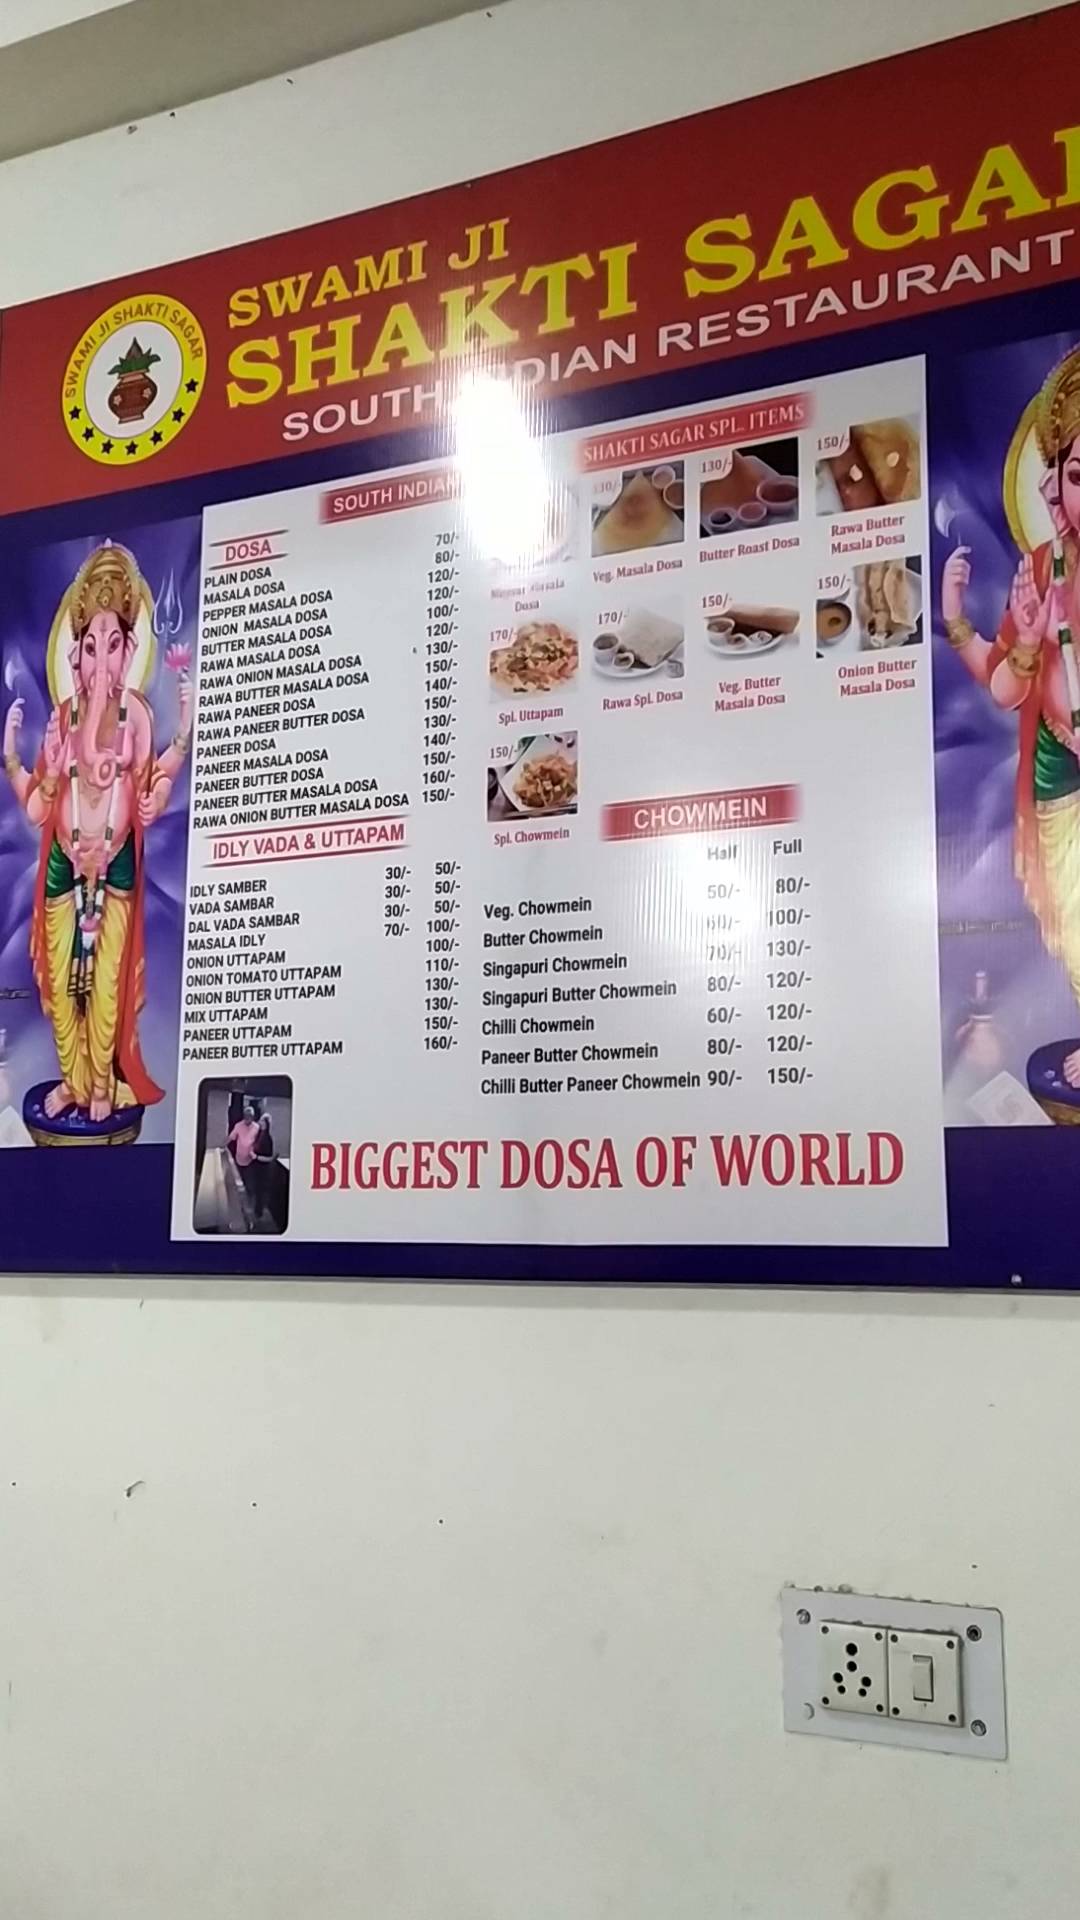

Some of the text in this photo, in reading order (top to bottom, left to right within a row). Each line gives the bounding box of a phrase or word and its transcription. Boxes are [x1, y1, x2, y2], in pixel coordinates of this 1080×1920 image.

[228, 218, 510, 329] SWAMI JI
[227, 242, 638, 408] SHAKTI
[283, 380, 444, 441] SOUTH
[657, 228, 1075, 356] RESTAURANT
[65, 302, 203, 399] SWAMI JI SHAKTI SAGAR
[584, 402, 805, 463] SHAKTI SAGAR SPL. ITEMS
[818, 431, 853, 450] 150/-
[333, 486, 393, 514] SOUTH
[831, 516, 904, 537] Rawa Butter
[435, 531, 459, 546] 70/-
[831, 534, 905, 554] Masala Dosa
[225, 539, 272, 561] DOSA
[435, 549, 459, 564] 80/-
[699, 537, 800, 562] Butter Roast Dosa
[204, 566, 272, 588] PLAIN DOSA
[427, 567, 459, 583] 120/-
[616, 562, 654, 578] Masala
[656, 559, 683, 572] Dosa
[818, 571, 854, 589] 150/-
[203, 581, 285, 605] MASALA DOSA
[427, 585, 459, 601] 120/-
[202, 590, 333, 622] PEPPER MASALA DOSA
[427, 604, 459, 619] 100/-
[202, 608, 328, 639] ONION MASALA DOSA
[598, 610, 631, 625] 170/-
[426, 622, 458, 637] 120/-
[201, 625, 332, 656] BUTTER MASALA DOSA
[200, 643, 321, 673] RAWA MASALA DOSA
[425, 658, 458, 673] 150/-
[837, 659, 917, 678] Onion Butter
[199, 672, 369, 707] RAWA BUTTER MASALA DOSA
[744, 677, 781, 690] Butter
[840, 678, 915, 696] Masala Dosa
[602, 698, 631, 710] Rawa
[656, 691, 683, 703] Dosa
[714, 694, 785, 711] Masala Dosa
[424, 713, 456, 728] 130/-
[519, 708, 563, 721] Uttapam
[196, 738, 276, 759] PANEER DOSA
[423, 750, 455, 765] 150/-
[195, 767, 324, 793] PANEER BUTTER DOSA
[422, 788, 455, 802] 150/-
[193, 793, 409, 828] RAWA ONION BUTTER MASALA DOSA
[634, 797, 766, 829] CHOWMEIN
[213, 824, 404, 859] IDLY VADA & UTTAPAM
[773, 839, 802, 855] Full
[385, 866, 411, 879] 30/-
[435, 861, 461, 875] 50/-
[190, 879, 267, 897] IDLY SAMBER
[384, 884, 411, 898] 30/-
[434, 880, 460, 894] 50/-
[775, 877, 810, 894] 80/-
[189, 896, 274, 915] VADA SAMBAR
[384, 903, 410, 917] 30/-
[434, 899, 460, 913] 50/-
[483, 897, 592, 921] Veg. Chowmein
[188, 913, 300, 933] DAL VADA SAMBAR
[426, 918, 460, 932] 100/-
[766, 908, 811, 926] 100/-
[384, 923, 410, 936] 70/-
[483, 926, 602, 947] Butter Chowmein
[187, 933, 266, 950] MASALA IDLY
[426, 938, 460, 952] 100/-
[767, 939, 811, 956] 130/-
[186, 951, 285, 969] ONION UTTAPAM
[425, 957, 459, 971] 110/-
[483, 954, 627, 979] Singapuri Chowmein
[186, 965, 341, 987] ONION TOMATO UTTAPAM
[707, 975, 741, 992] 80/-
[766, 971, 812, 988] 120/-
[425, 996, 458, 1010] 130/-
[482, 981, 676, 1008] Singapuri Butter Chowmein
[184, 1007, 268, 1023] MIX UTTAPAM
[707, 1007, 742, 1023] 60/-
[766, 1003, 812, 1020] 120/-
[482, 1016, 594, 1035] Chilli Chowmein
[182, 1041, 343, 1060] PANEER BUTTER UTTAPAM
[424, 1036, 458, 1050] 160/-
[481, 1072, 700, 1094] Chilli Butter Paneer Chowmein
[707, 1070, 742, 1086] 90/-
[767, 1067, 813, 1084] 150/-
[310, 1132, 903, 1189] BIGGEST DOSA OF WORLD
